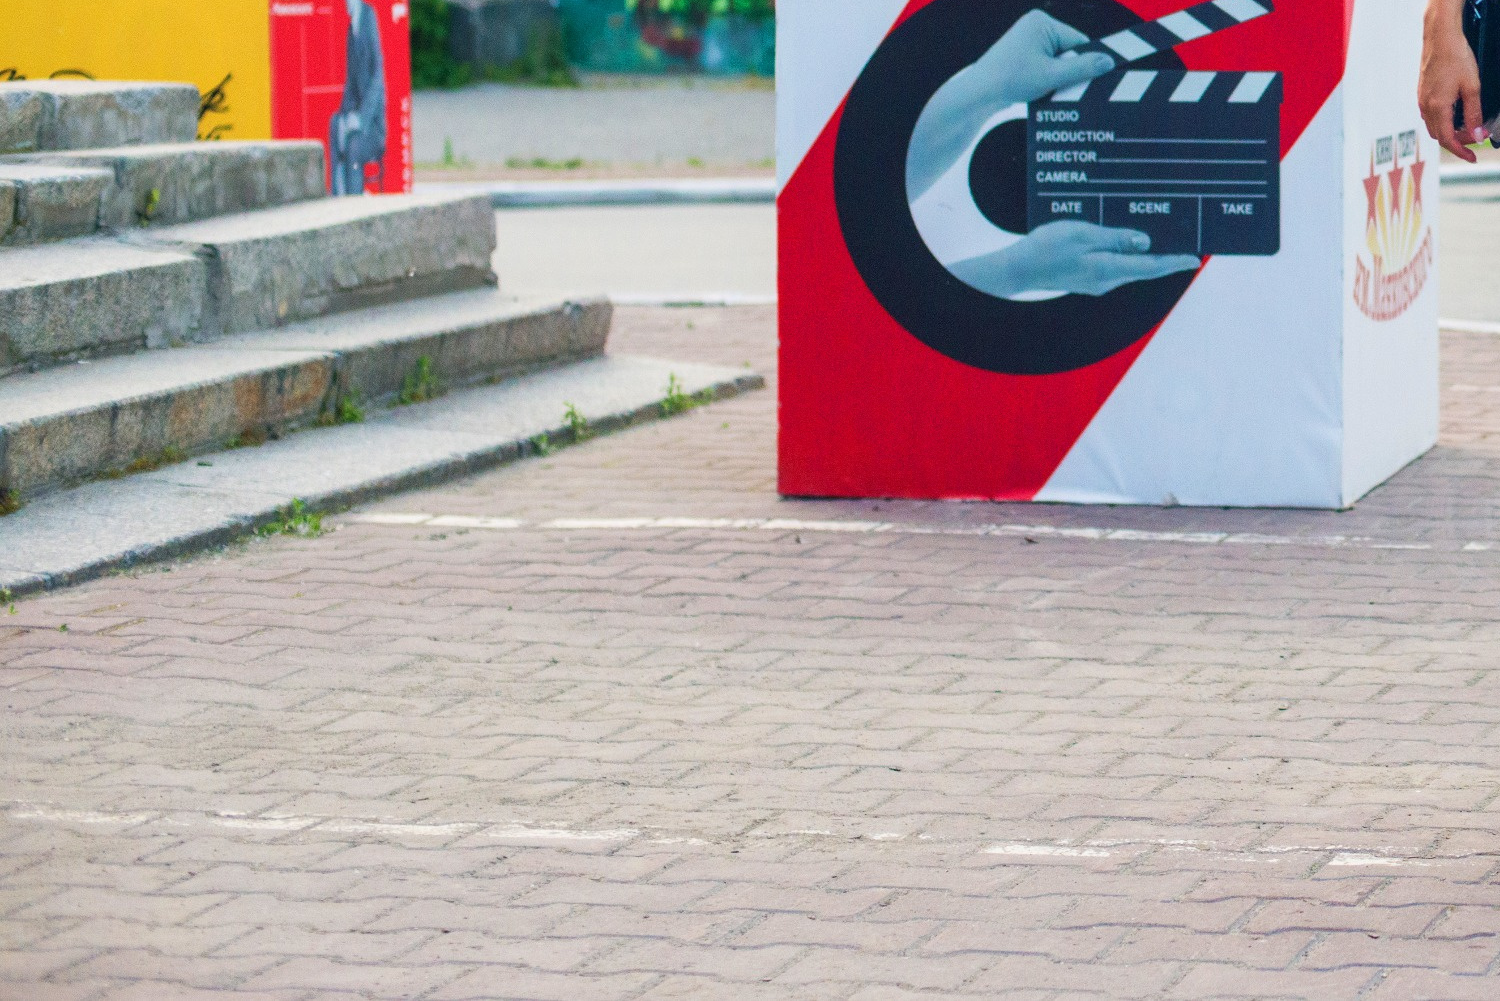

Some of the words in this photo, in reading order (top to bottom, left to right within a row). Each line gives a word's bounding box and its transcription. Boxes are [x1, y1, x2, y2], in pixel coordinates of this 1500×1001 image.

[1036, 110, 1079, 122] STUDIO
[1036, 131, 1115, 142] PRODUCTION
[1036, 151, 1097, 162] DIRECTOR
[1036, 171, 1088, 183] CAMERA
[1051, 201, 1082, 213] DATE
[1129, 202, 1170, 214] SCENE
[1221, 203, 1253, 215] TAKE
